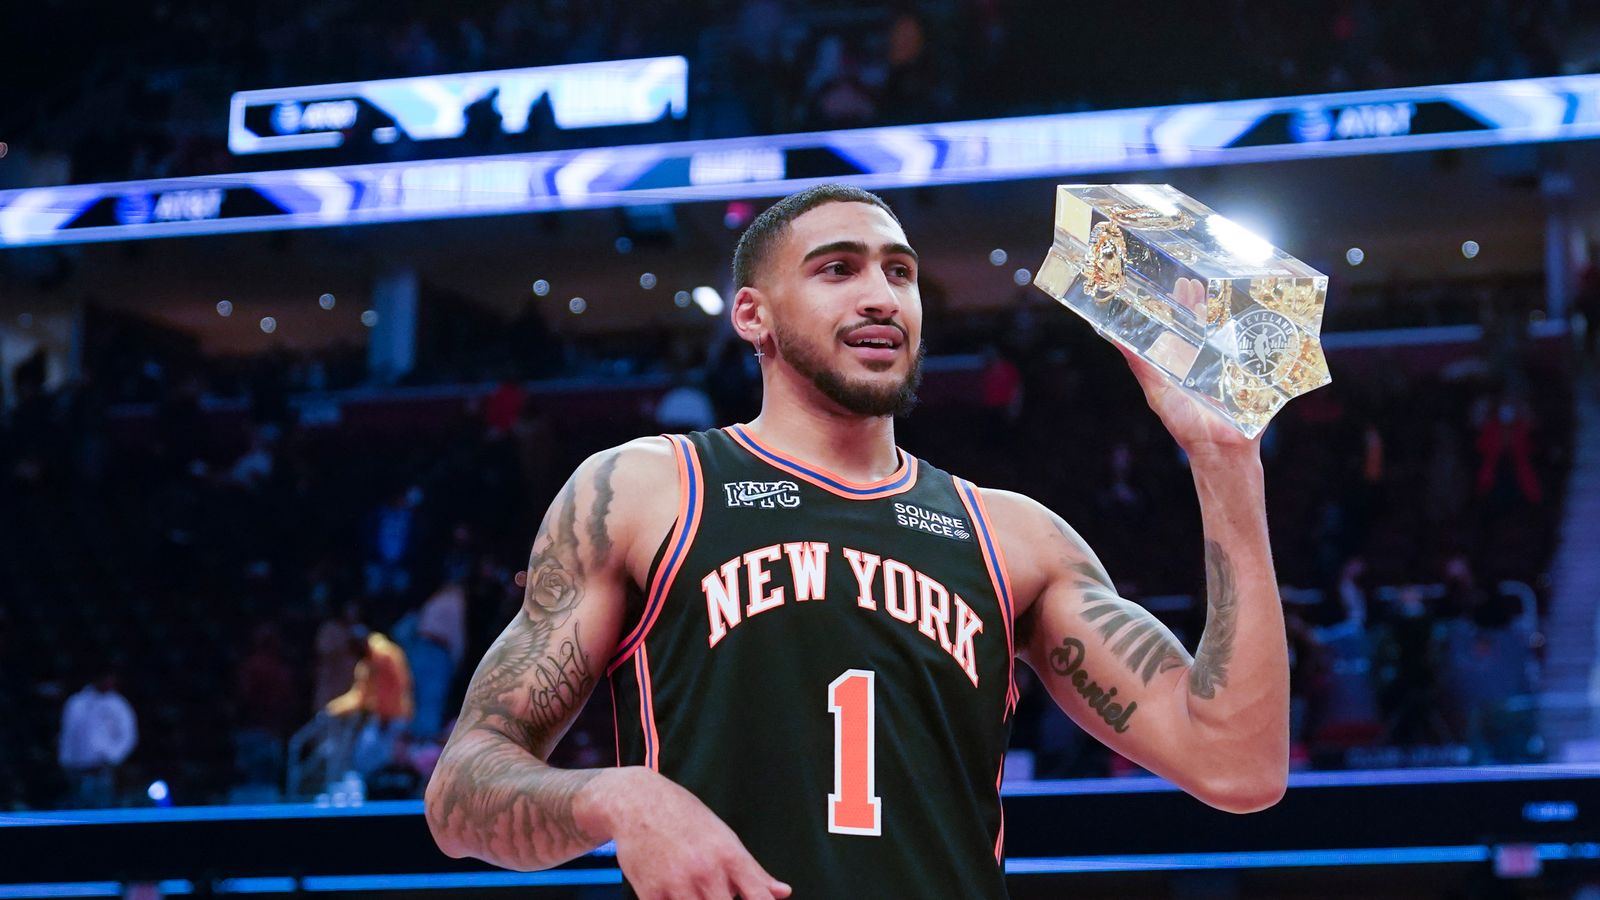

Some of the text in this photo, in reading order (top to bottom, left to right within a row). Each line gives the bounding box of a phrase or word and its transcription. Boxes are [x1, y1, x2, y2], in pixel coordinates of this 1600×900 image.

[1234, 312, 1294, 337] CLEVELAND
[724, 480, 801, 508] NYC
[894, 502, 965, 529] SQUARE
[897, 514, 954, 537] SPACE
[701, 541, 984, 688] NEW YORK
[1050, 637, 1138, 734] Daniel
[828, 668, 882, 837] 1
